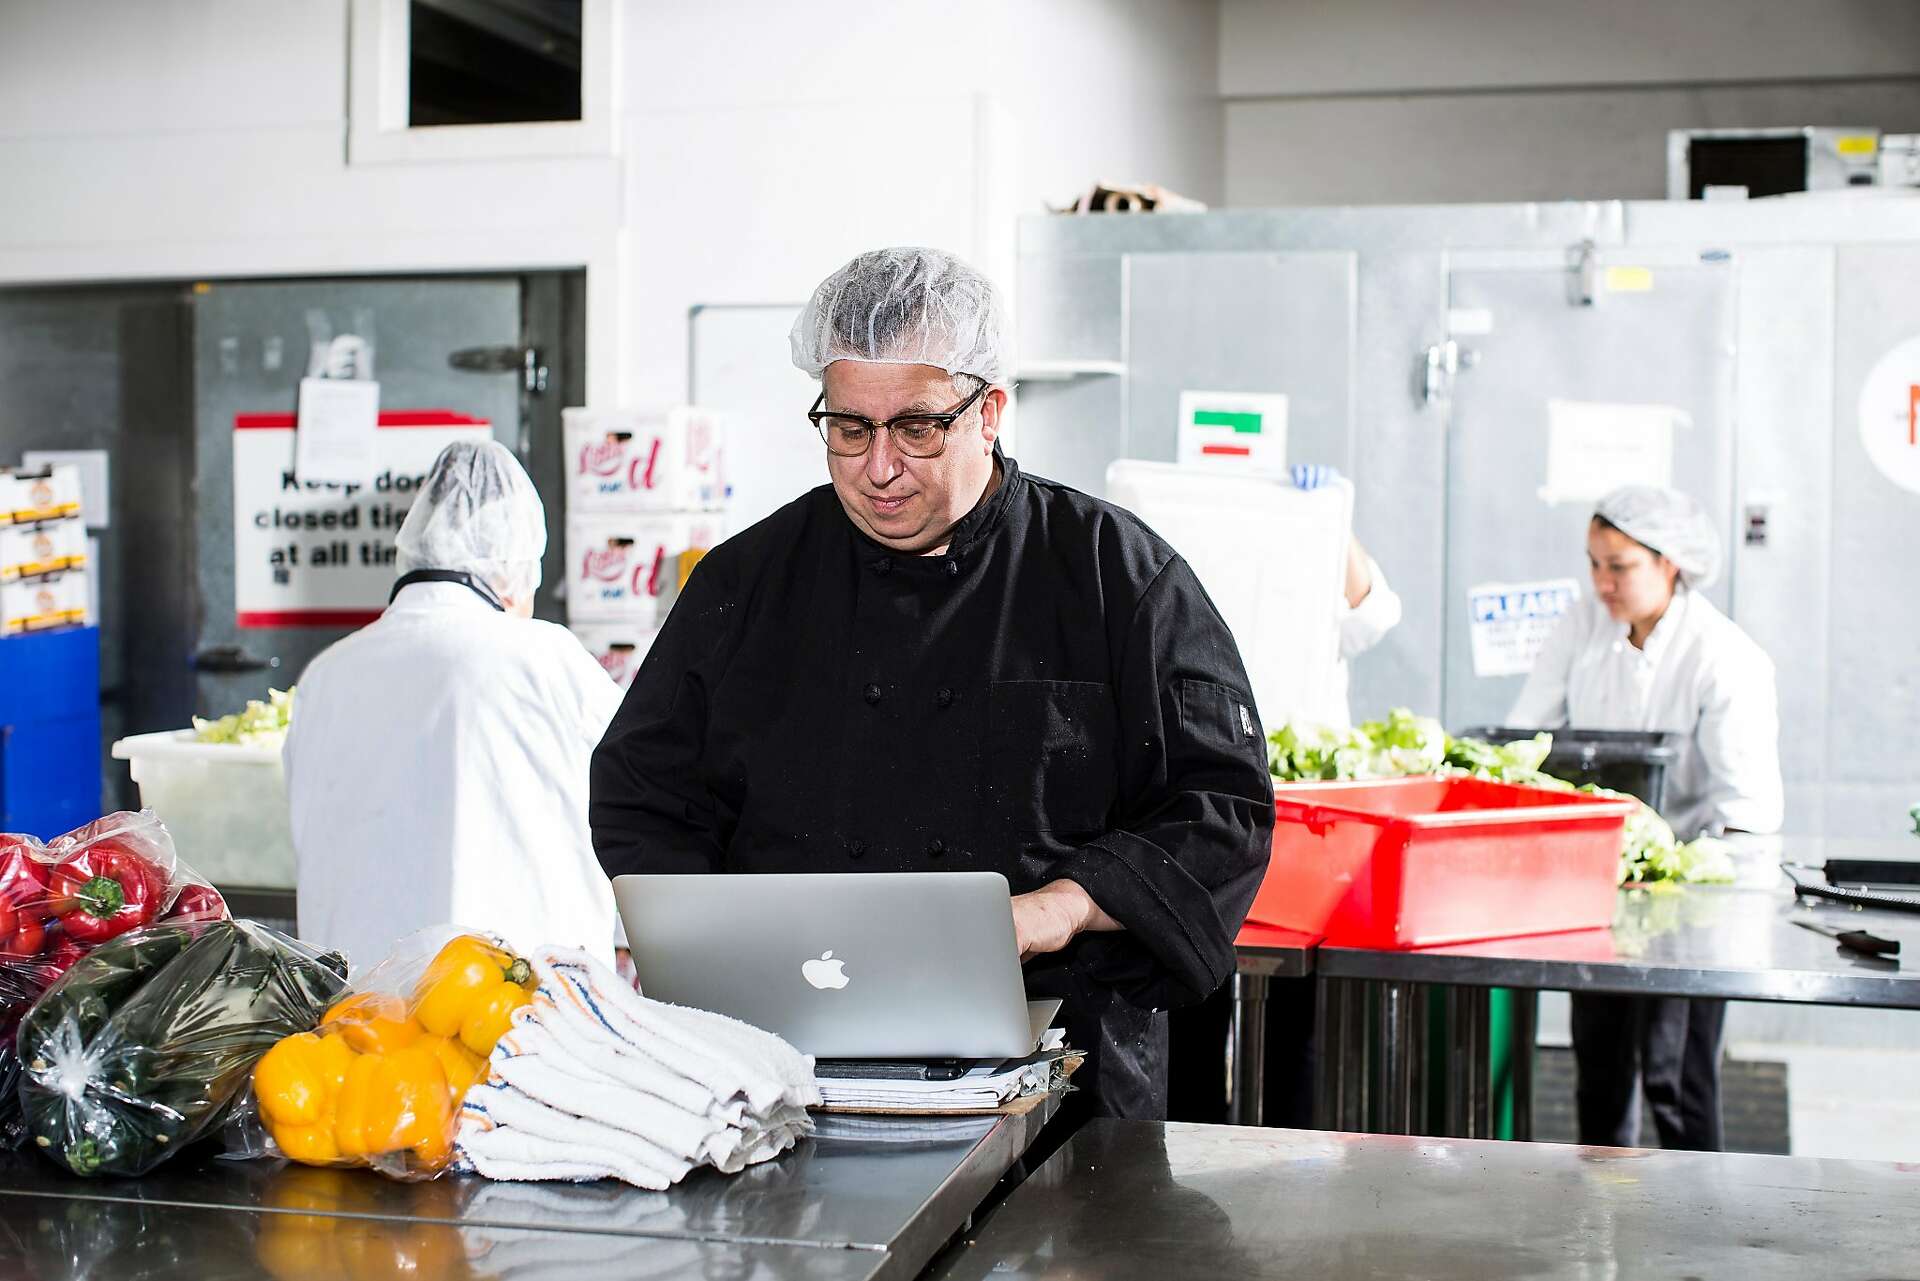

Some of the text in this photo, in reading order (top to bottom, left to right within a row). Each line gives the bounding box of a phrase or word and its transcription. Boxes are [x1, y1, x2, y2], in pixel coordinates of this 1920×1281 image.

[281, 471, 427, 495] Kp do
[255, 505, 408, 531] closed tig
[270, 544, 298, 565] at
[310, 541, 348, 566] all
